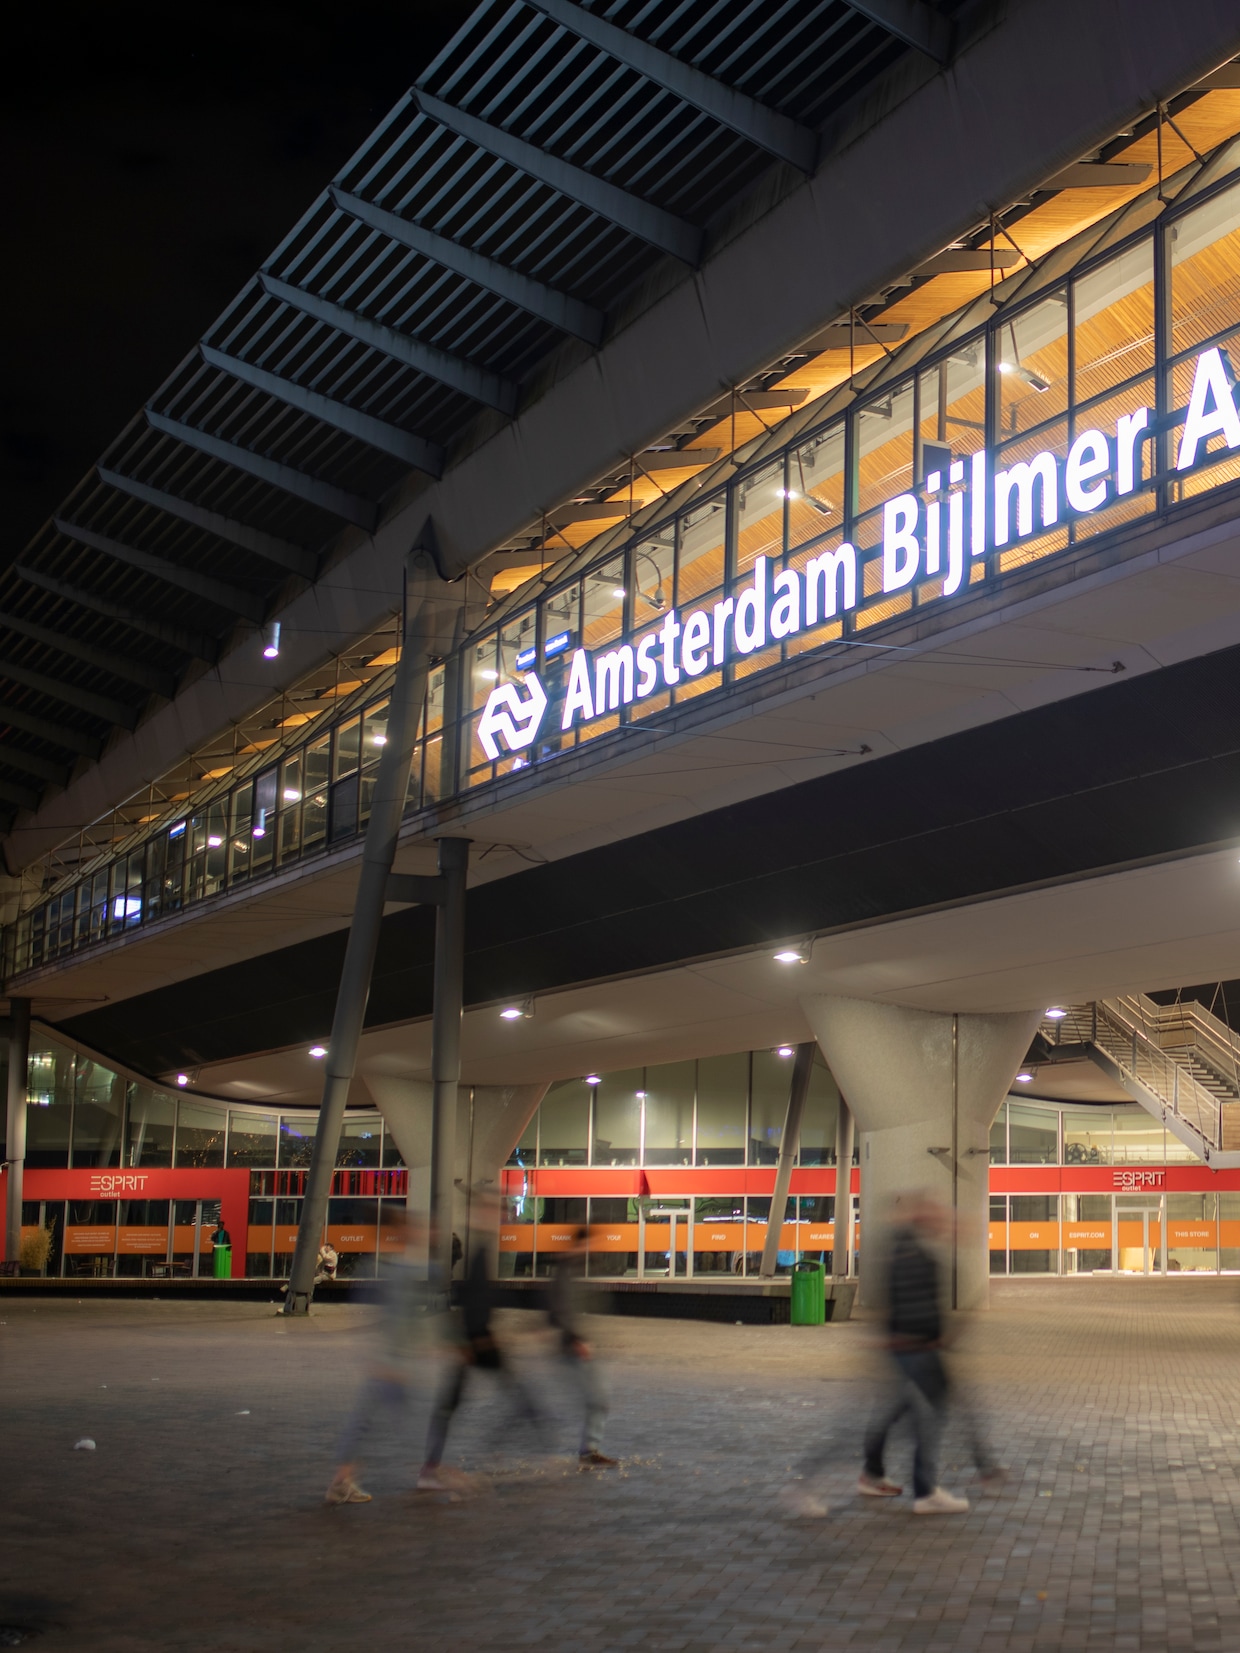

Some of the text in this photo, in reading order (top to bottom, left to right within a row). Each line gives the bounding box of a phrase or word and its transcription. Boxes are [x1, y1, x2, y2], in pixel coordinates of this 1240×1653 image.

[561, 541, 857, 731] Amsterdam
[882, 406, 1149, 597] Bijlmer
[90, 1175, 149, 1191] ESPRIT
[1113, 1171, 1165, 1187] ESPRIT
[100, 1190, 121, 1198] outlet
